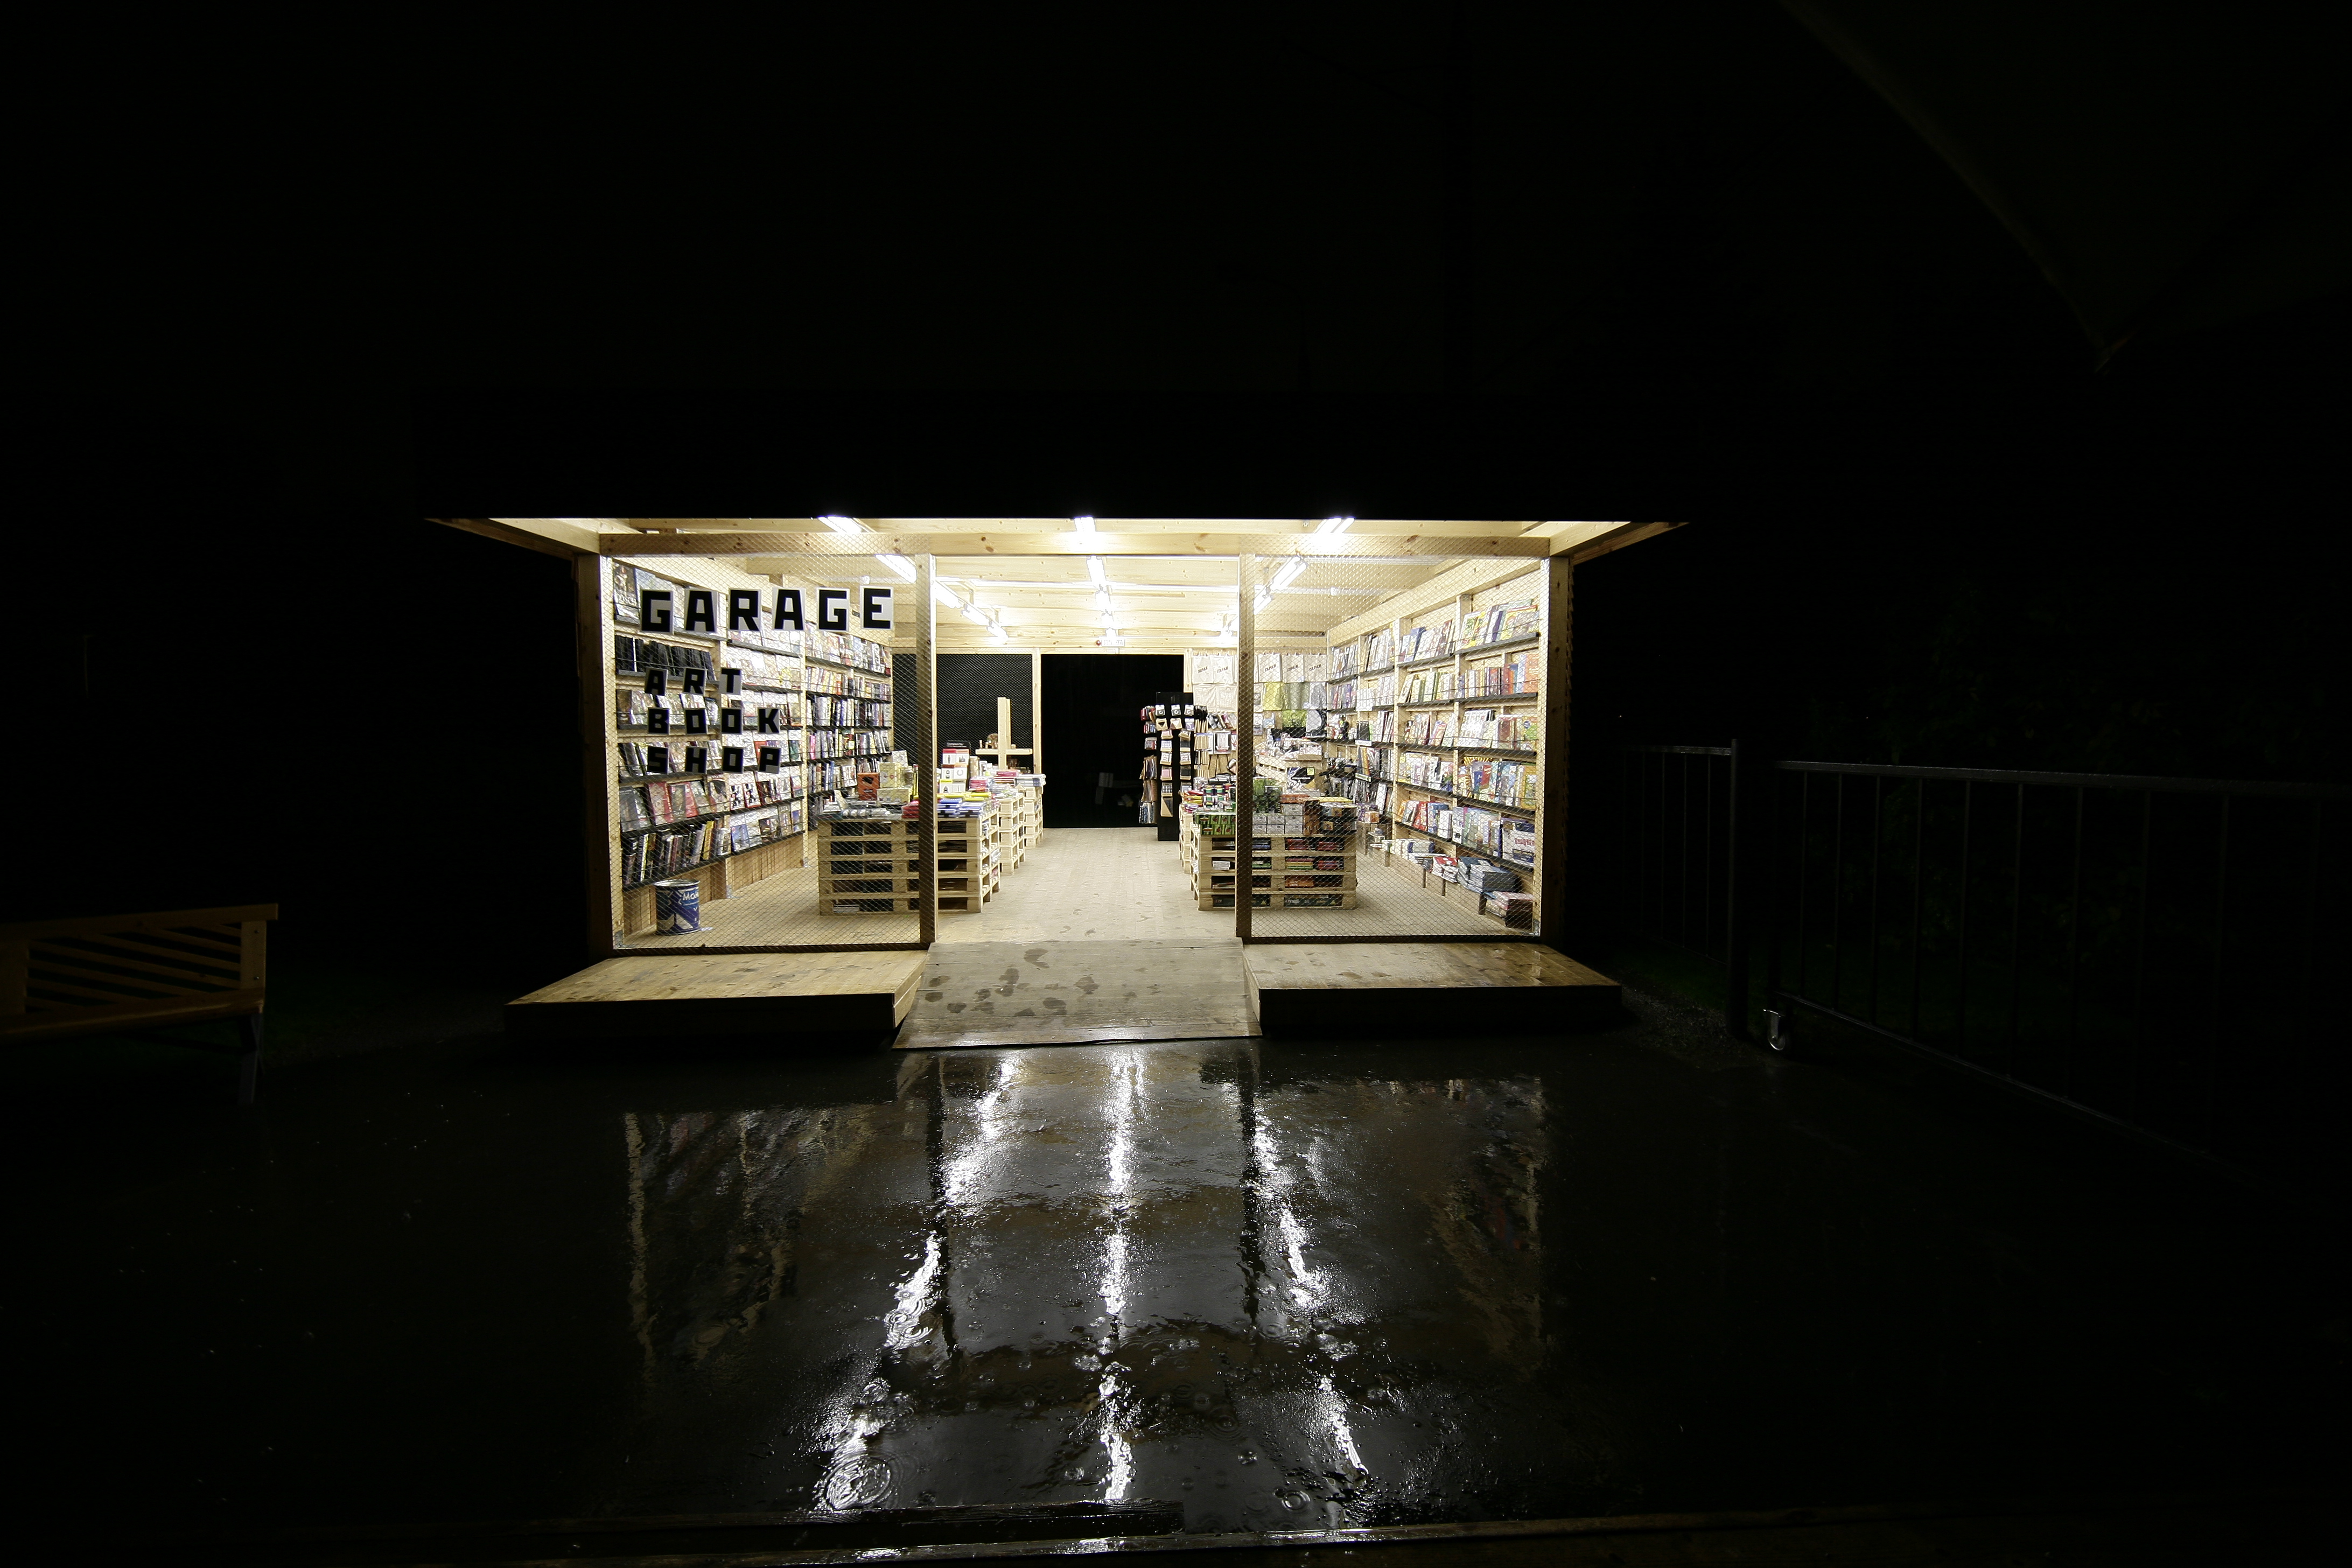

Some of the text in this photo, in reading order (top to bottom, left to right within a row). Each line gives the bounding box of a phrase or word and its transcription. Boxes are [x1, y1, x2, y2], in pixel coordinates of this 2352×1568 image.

[641, 589, 891, 632] GARAGE
[645, 668, 741, 695] ART
[648, 709, 779, 733] BOOK
[647, 747, 779, 773] SHOP
